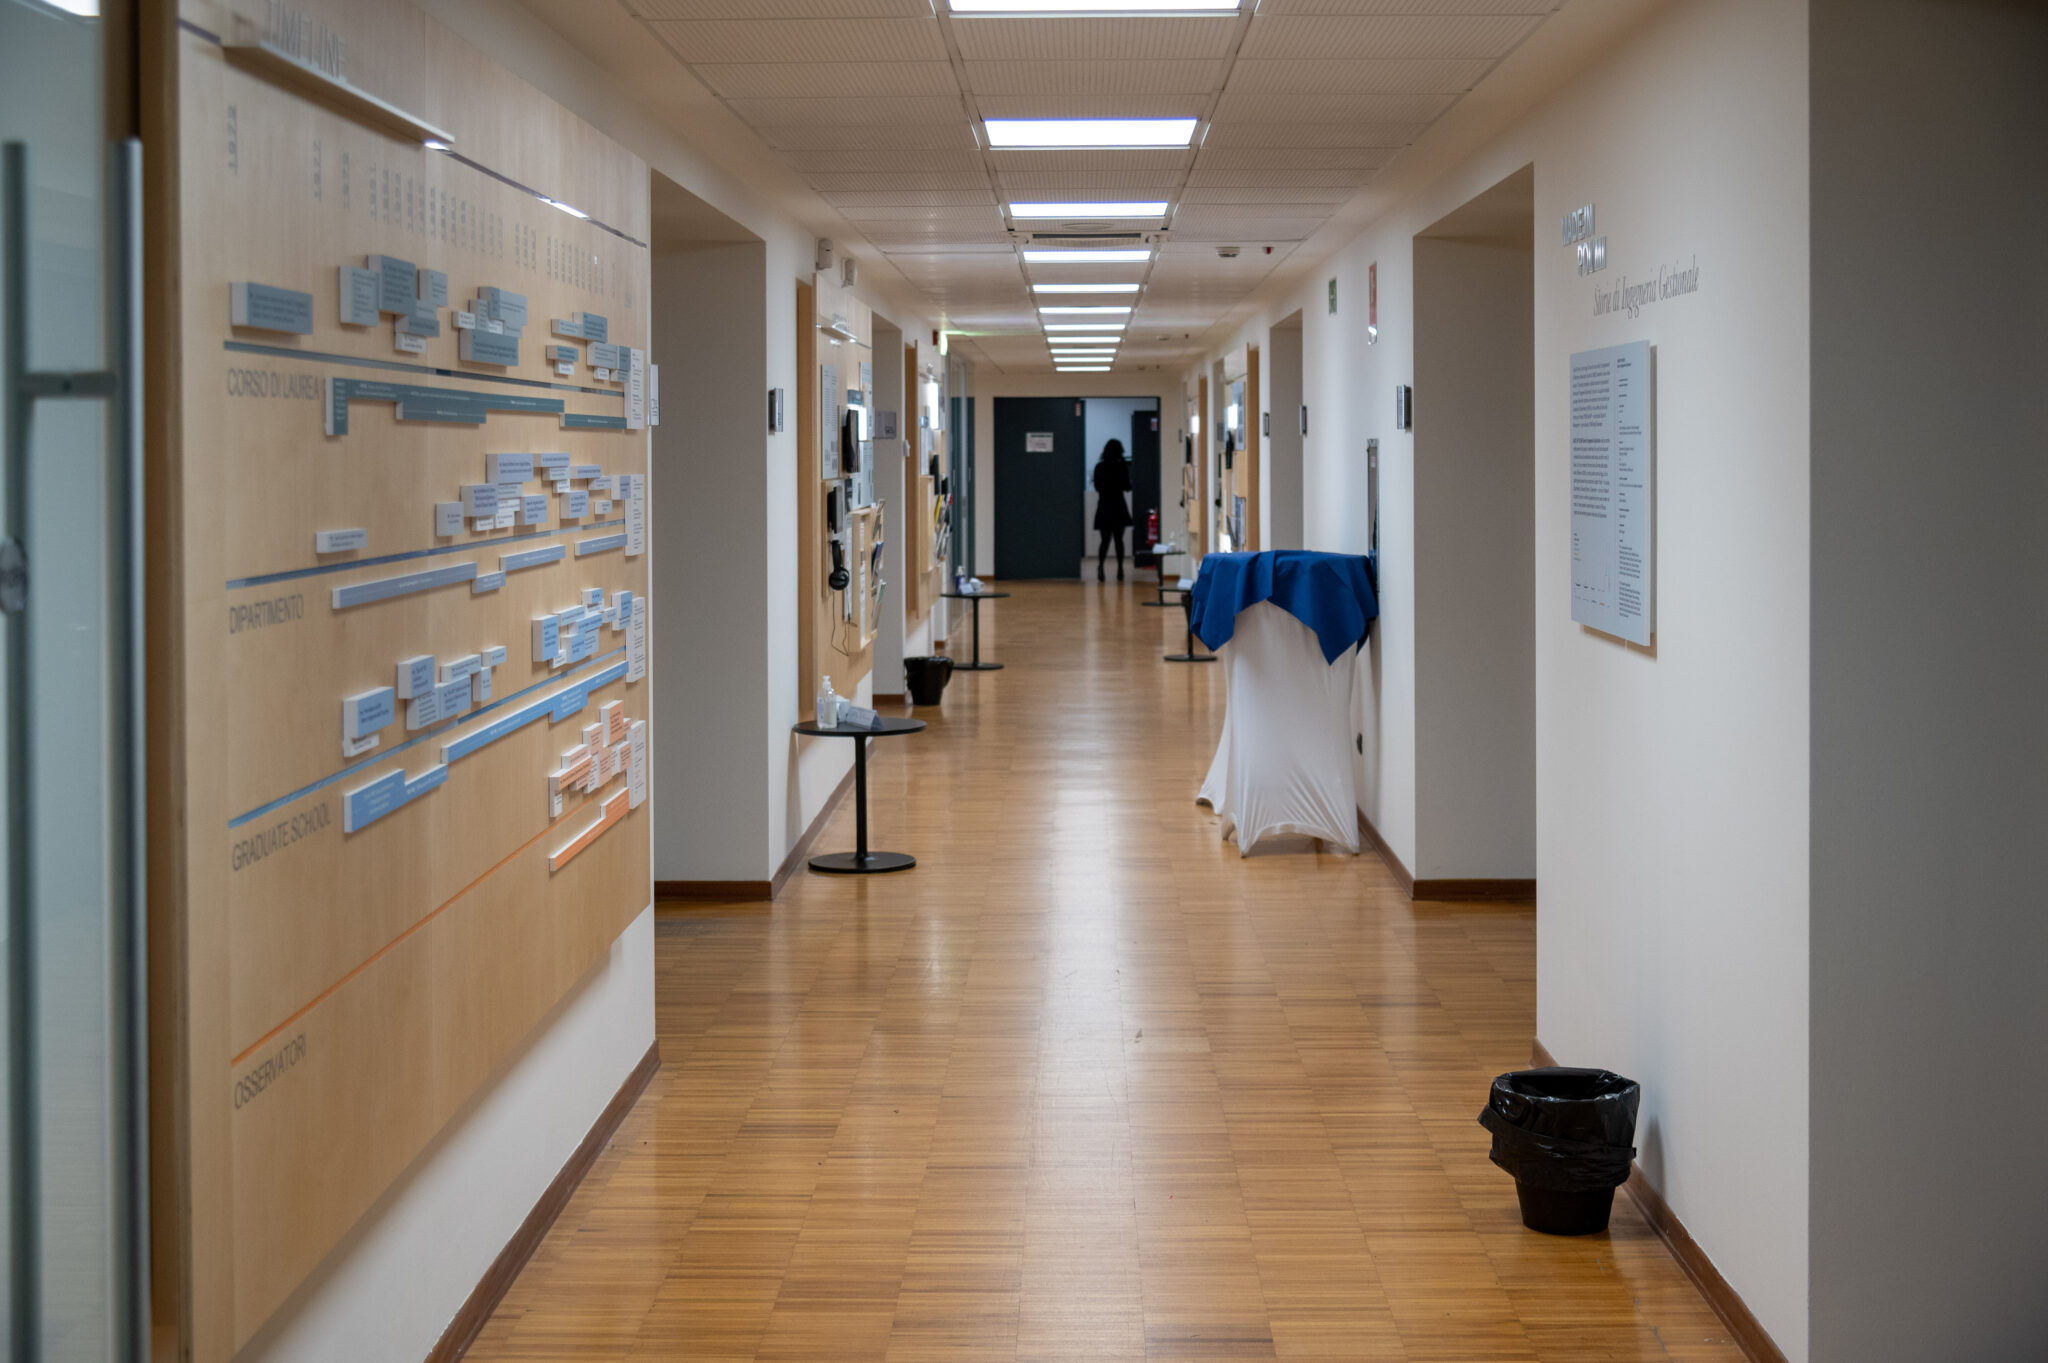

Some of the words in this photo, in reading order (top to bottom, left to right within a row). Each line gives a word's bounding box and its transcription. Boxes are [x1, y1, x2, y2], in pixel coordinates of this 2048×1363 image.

[227, 367, 268, 398] CORSO
[230, 593, 305, 635] DIPARTIMENTO
[232, 821, 289, 871] GRADUATE
[290, 802, 332, 843] SCHOOL
[234, 1031, 307, 1110] OSSERVATORI
